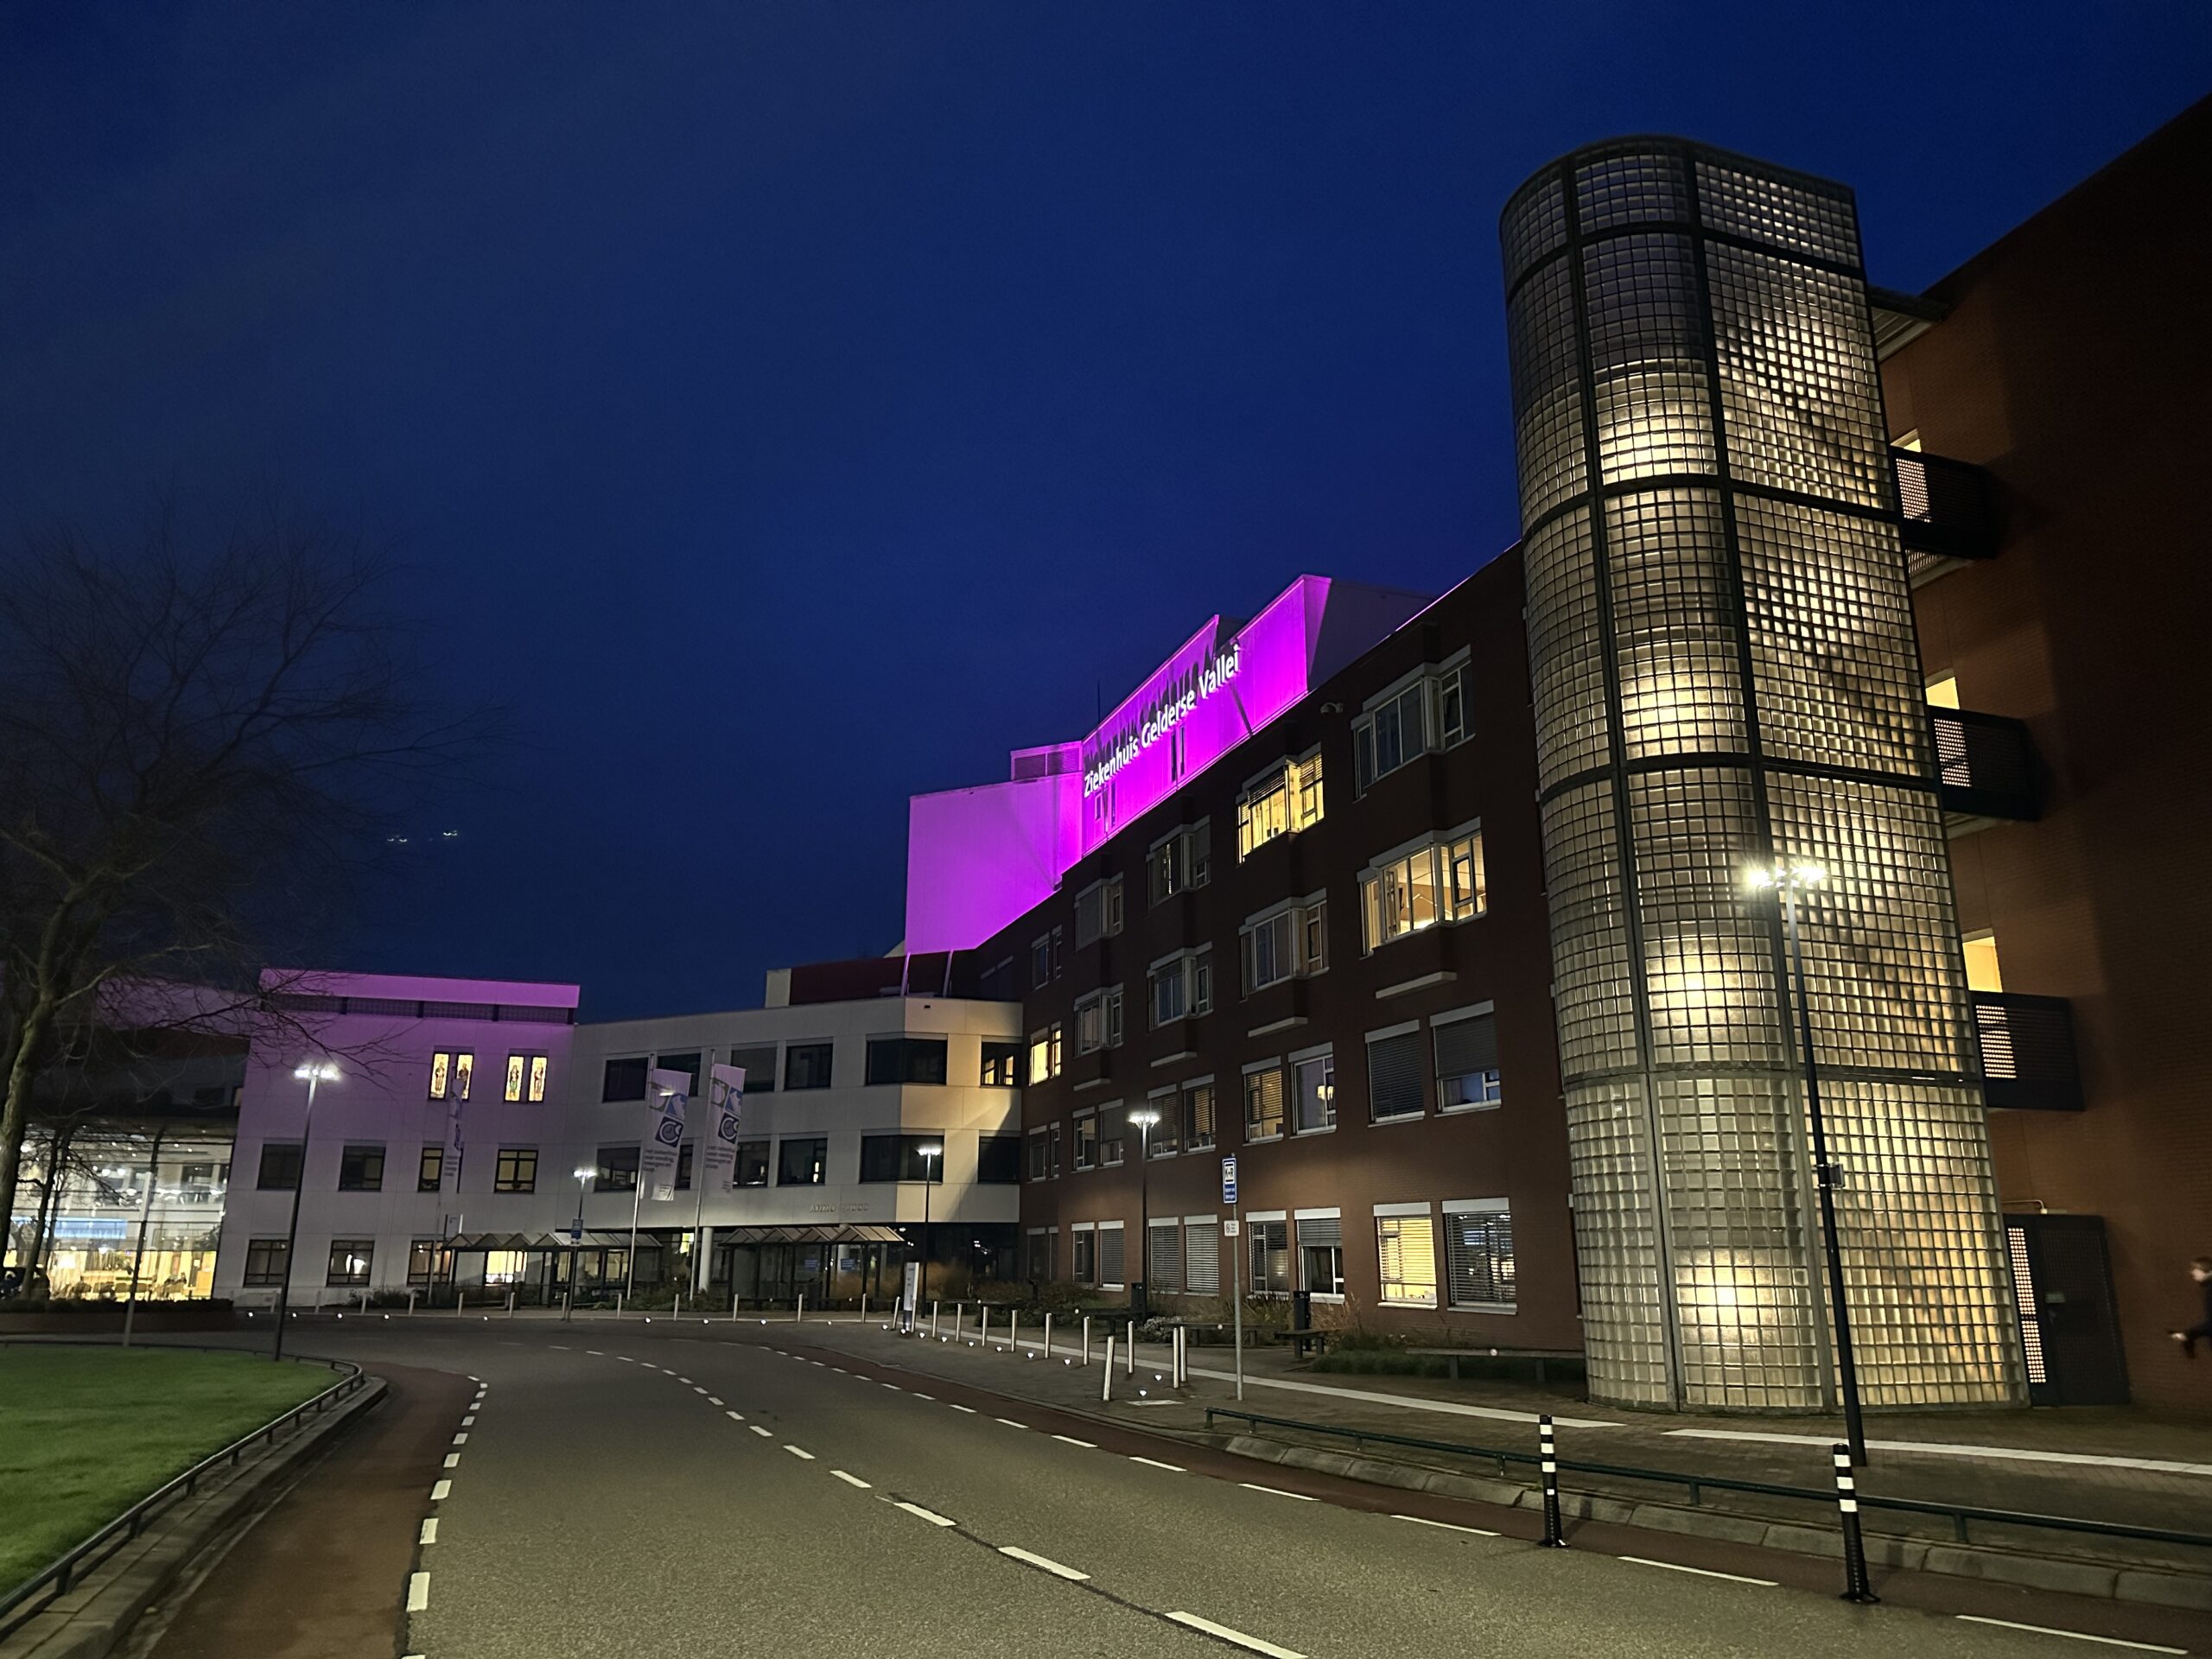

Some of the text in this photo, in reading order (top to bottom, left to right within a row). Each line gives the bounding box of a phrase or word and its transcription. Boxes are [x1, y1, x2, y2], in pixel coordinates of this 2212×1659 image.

[1084, 644, 1241, 798] Ziekenhuis Gelderse Vallei
